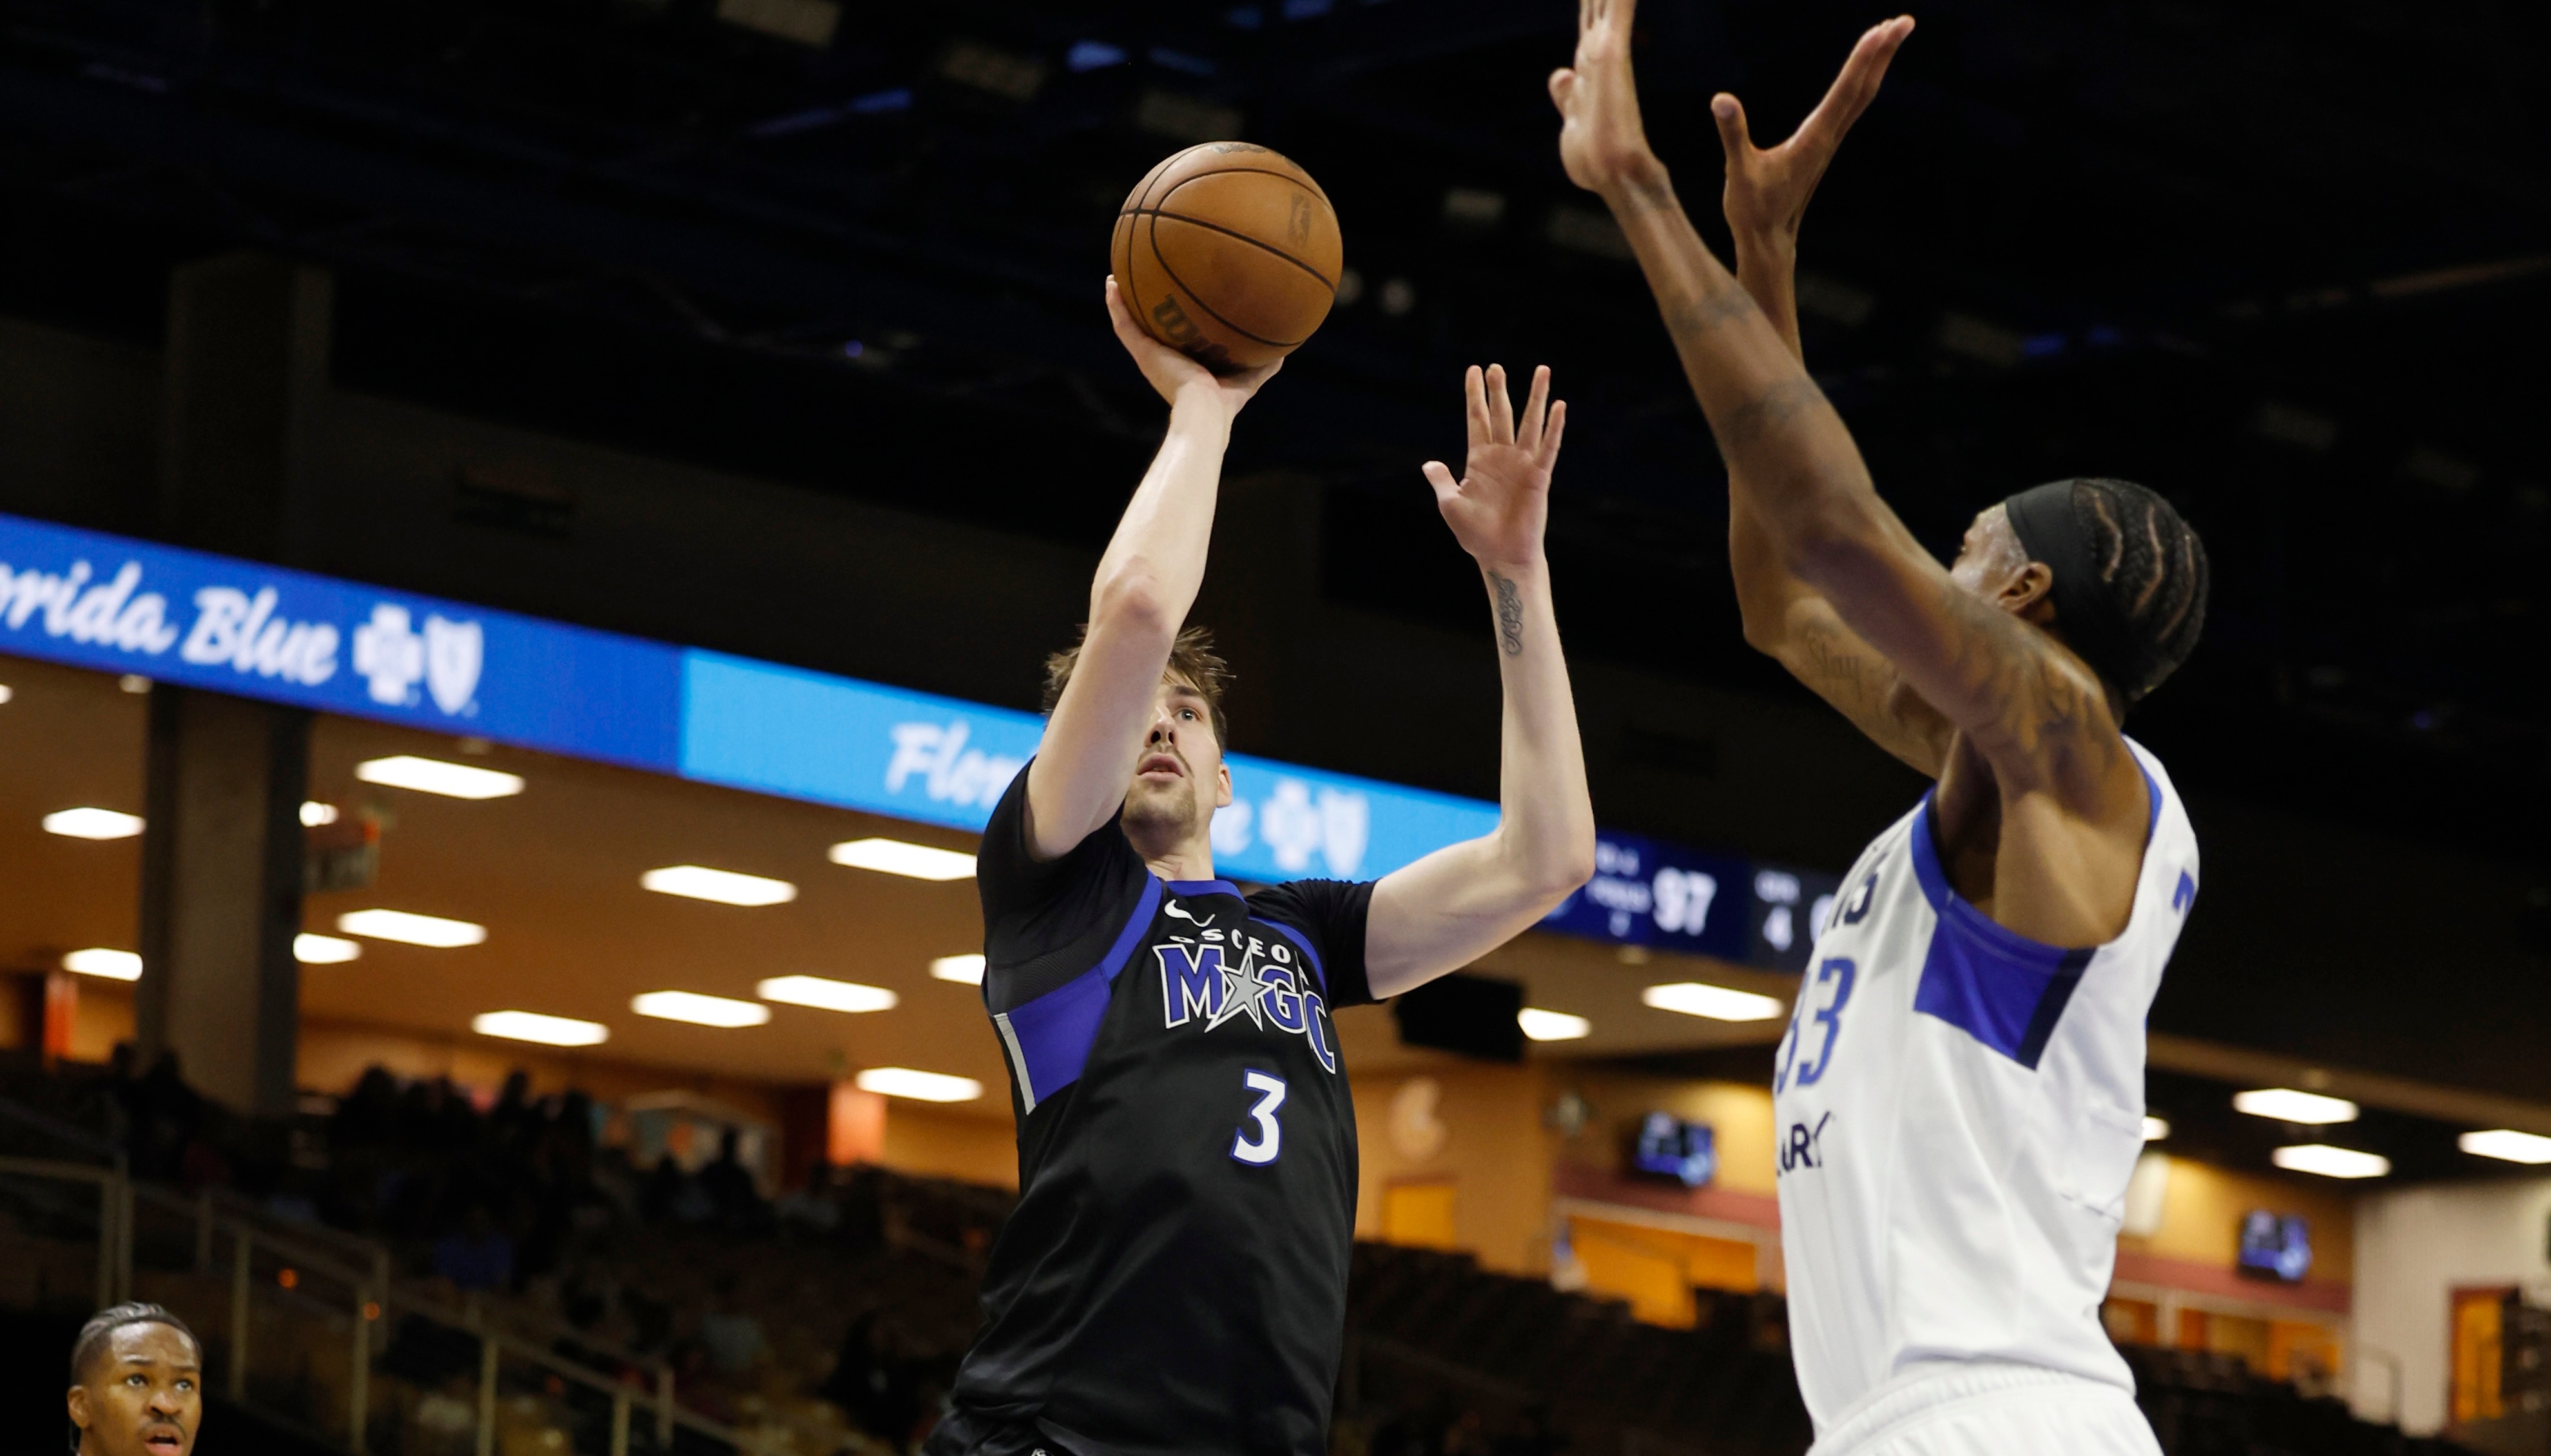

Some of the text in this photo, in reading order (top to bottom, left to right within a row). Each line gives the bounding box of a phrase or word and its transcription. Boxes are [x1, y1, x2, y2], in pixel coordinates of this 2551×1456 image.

[181, 586, 339, 686] Blue
[884, 719, 1036, 810] Flor
[1652, 867, 1717, 937] 97
[1169, 928, 1310, 986] OSCEOA
[1152, 943, 1336, 1074] MGC
[1230, 1067, 1288, 1167] 3
